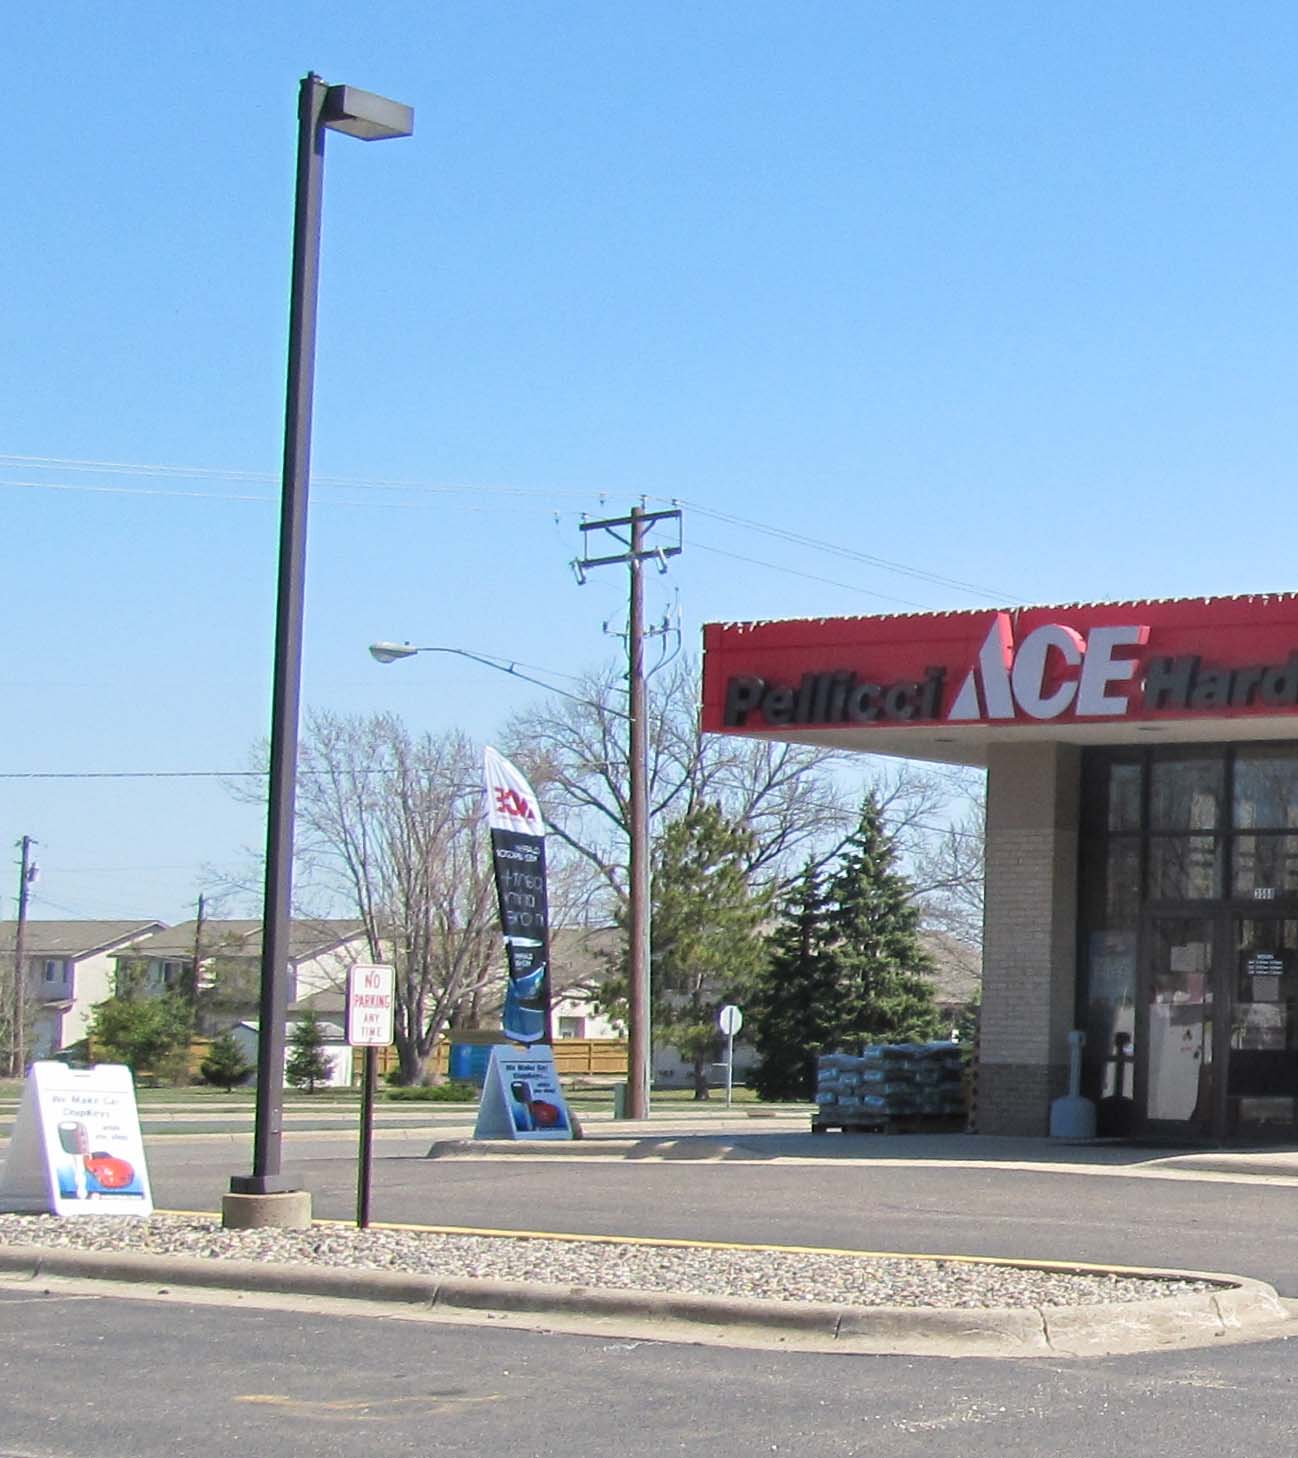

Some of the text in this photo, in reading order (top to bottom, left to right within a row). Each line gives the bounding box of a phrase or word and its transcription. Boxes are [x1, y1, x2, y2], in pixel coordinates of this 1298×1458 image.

[724, 666, 948, 727] Pellicci
[947, 611, 1150, 720] ACE
[364, 974, 380, 988] NO
[353, 994, 391, 1008] PARKING
[364, 1013, 381, 1023] ANY
[361, 1026, 383, 1037] TIME
